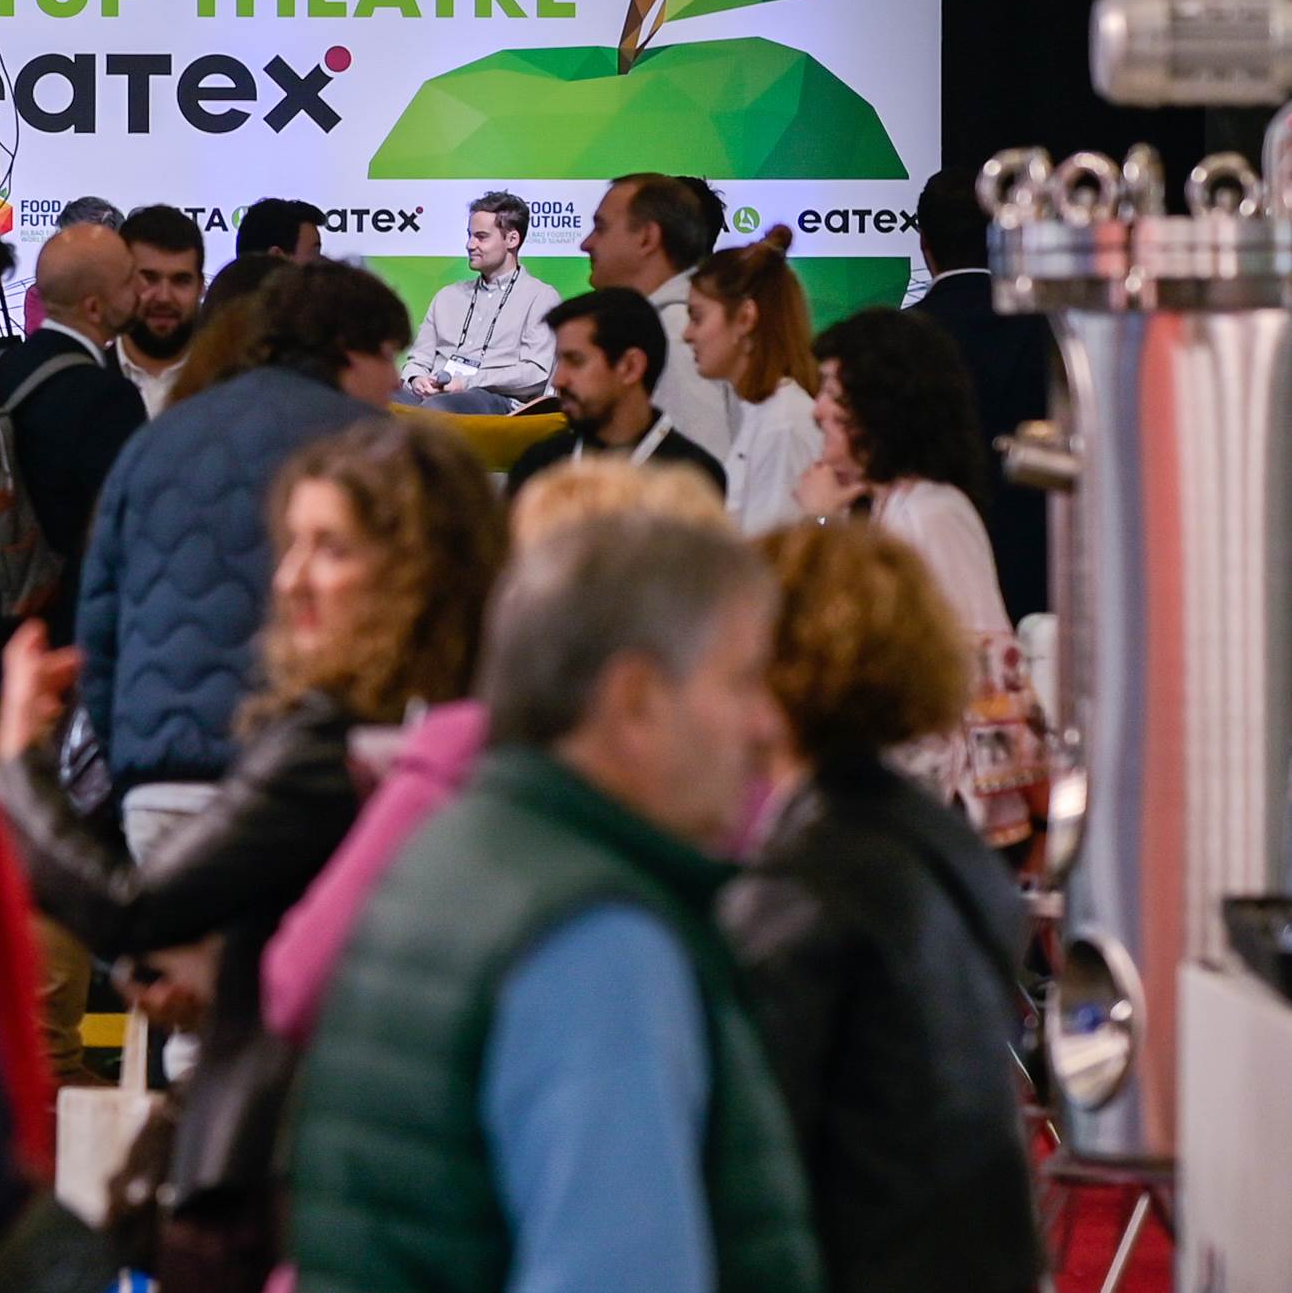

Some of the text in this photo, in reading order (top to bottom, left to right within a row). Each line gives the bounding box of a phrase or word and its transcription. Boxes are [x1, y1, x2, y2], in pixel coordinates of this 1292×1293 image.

[20, 199, 61, 213] FOOD
[525, 201, 575, 215] OOD 4
[20, 214, 61, 227] FUTU
[184, 207, 229, 232] TA
[530, 215, 582, 229] UTURE
